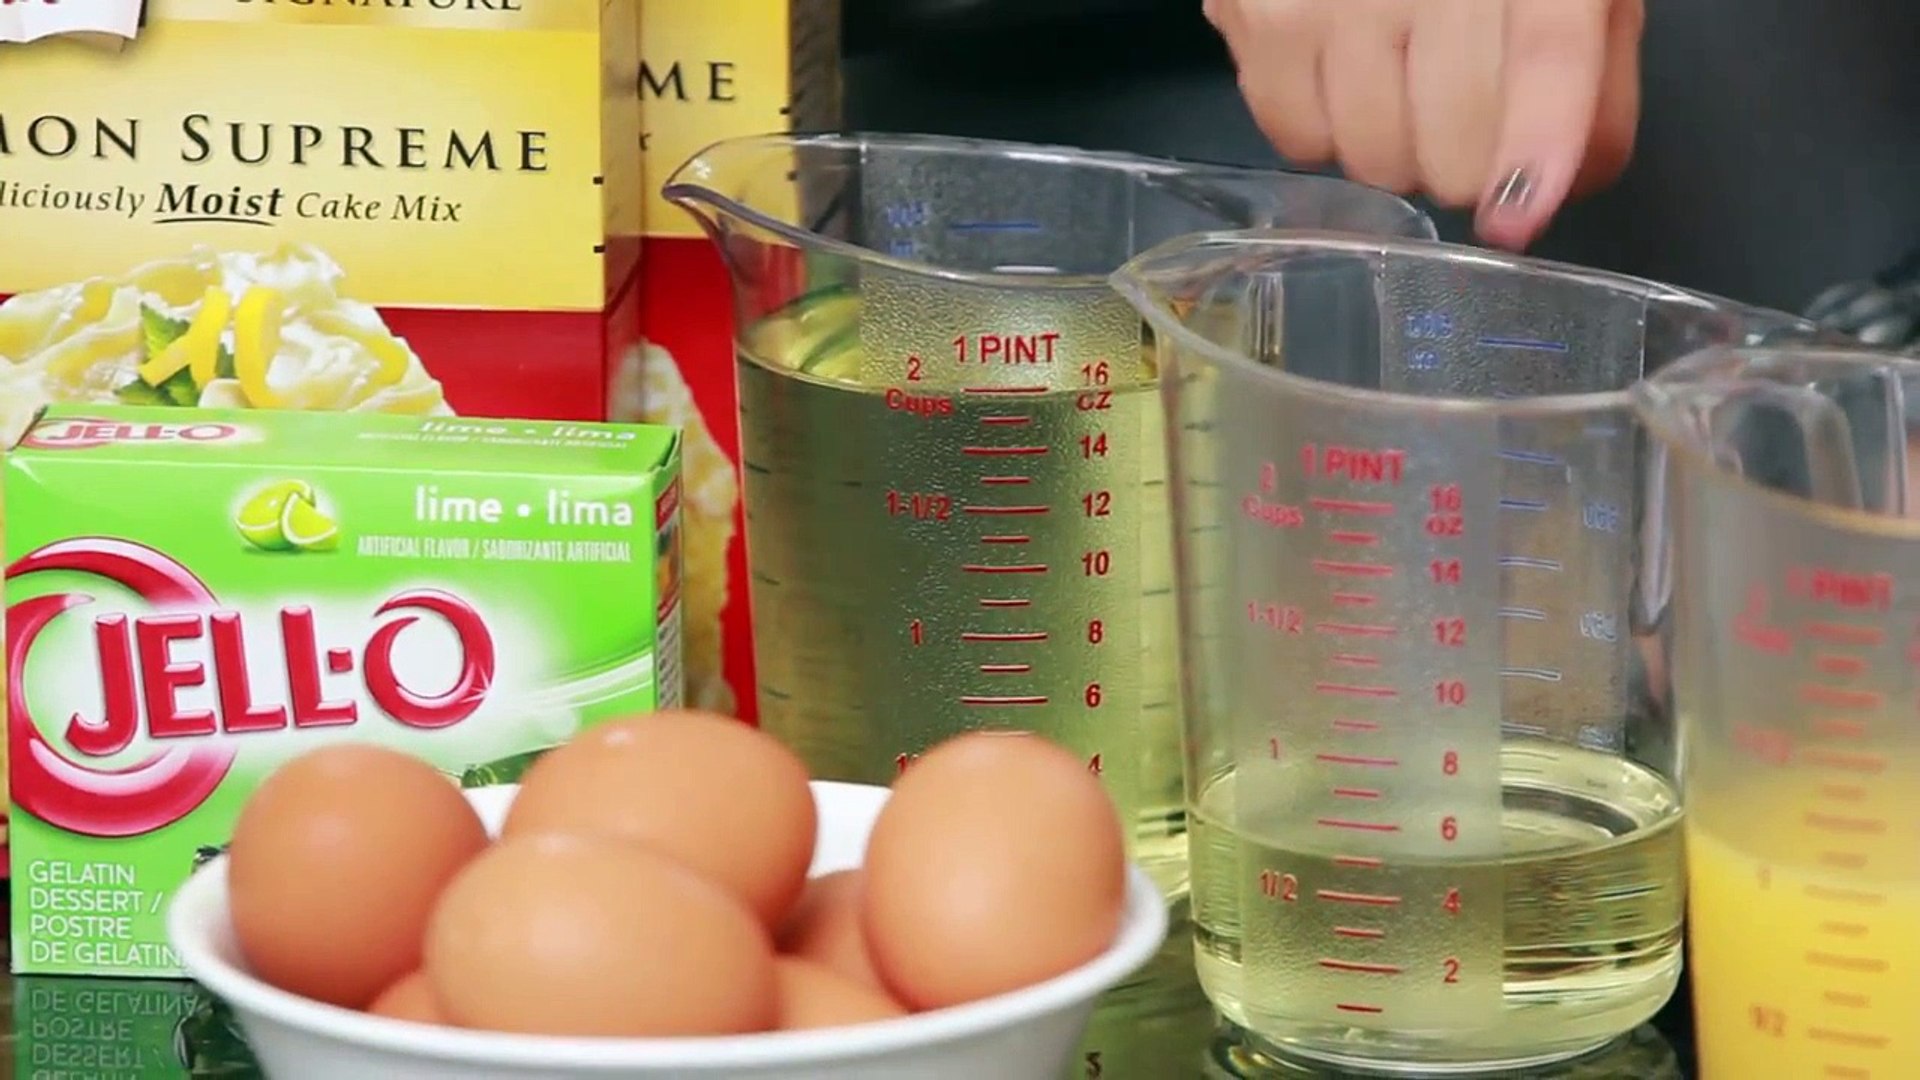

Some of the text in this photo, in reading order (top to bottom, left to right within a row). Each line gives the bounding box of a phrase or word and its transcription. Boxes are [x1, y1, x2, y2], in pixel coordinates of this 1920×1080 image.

[0, 113, 548, 171] ON SUPREME
[154, 183, 284, 217] Moist
[296, 192, 381, 220] Cake
[391, 194, 463, 222] Mix
[953, 333, 1060, 364] 1 PINT
[907, 357, 921, 381] 2
[1081, 361, 1109, 386] 16
[885, 387, 954, 418] Cups
[1080, 433, 1107, 459] 14
[1324, 447, 1404, 485] PINT
[415, 484, 503, 523] lime
[548, 488, 633, 526] lima
[887, 491, 951, 521] 1-1/2
[1082, 491, 1110, 517] 12
[1082, 550, 1109, 577] 10
[1431, 559, 1462, 585] 14
[910, 619, 923, 646] 1
[1088, 619, 1103, 644] 8
[1433, 617, 1466, 647] 12
[65, 586, 496, 757] JELL-O
[1085, 683, 1102, 708] 6
[1435, 681, 1467, 706] 10
[1269, 737, 1280, 760] 1
[1442, 751, 1459, 775] 8
[1441, 816, 1458, 841] 6
[29, 860, 135, 886] GELATIN
[1259, 869, 1298, 902] 1/2
[29, 887, 144, 914] DESSERT
[30, 915, 132, 938] POSTRE
[31, 940, 183, 968] DE GELATIN
[1443, 958, 1459, 983] 2
